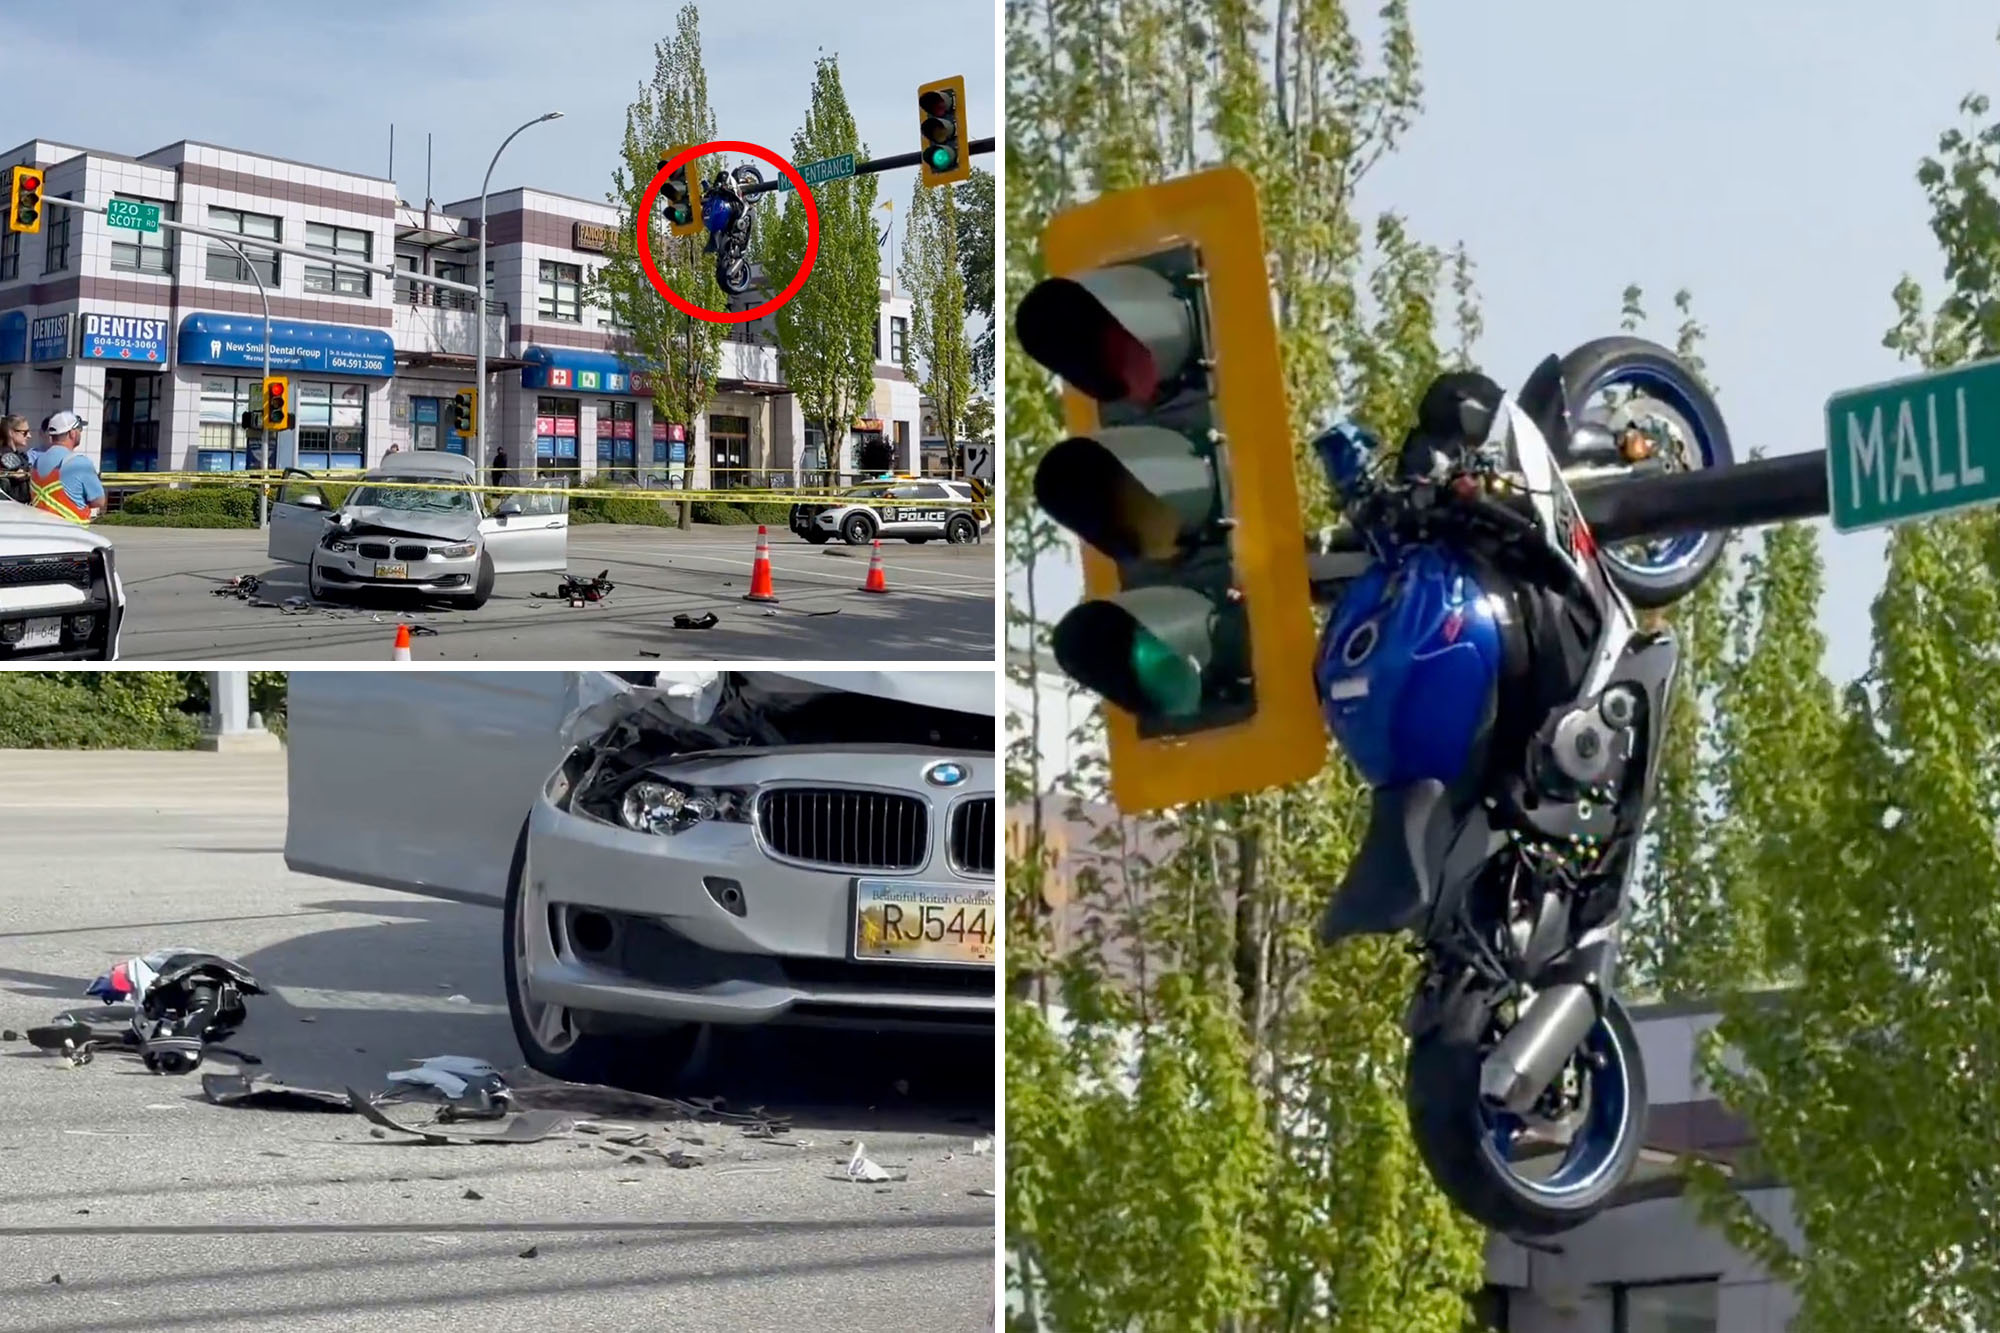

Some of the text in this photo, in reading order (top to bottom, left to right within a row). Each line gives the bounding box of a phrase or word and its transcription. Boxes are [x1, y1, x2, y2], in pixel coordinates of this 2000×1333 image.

[804, 157, 851, 182] ENTRANCE
[112, 202, 155, 216] 120 ST
[109, 215, 156, 228] SCOTT RD
[33, 315, 68, 339] DENTIST
[86, 315, 167, 340] DENTIST
[93, 337, 157, 349] 604-591-3060
[226, 342, 320, 361] New Smil Dental Group
[332, 357, 382, 370] 604.591.3060
[1848, 387, 1985, 509] MALL
[898, 511, 946, 521] POLICE
[872, 890, 916, 902] Beautiful
[919, 892, 951, 904] British
